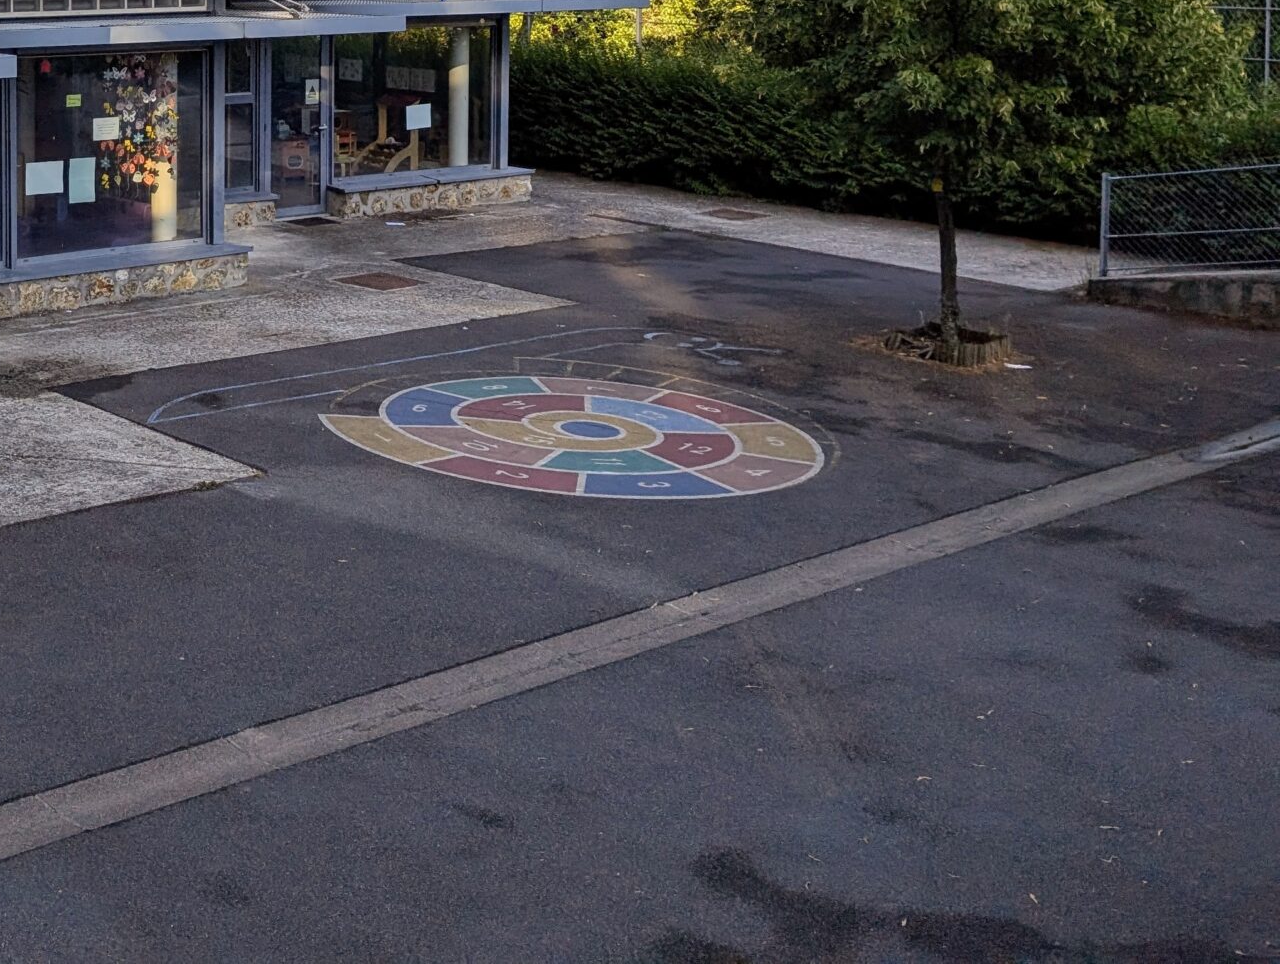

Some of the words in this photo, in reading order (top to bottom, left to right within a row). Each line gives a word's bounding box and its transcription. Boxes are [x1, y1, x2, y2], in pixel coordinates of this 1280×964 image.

[678, 442, 713, 455] 12
[495, 469, 530, 479] 2
[744, 467, 773, 477] 4
[637, 481, 672, 489] 3
